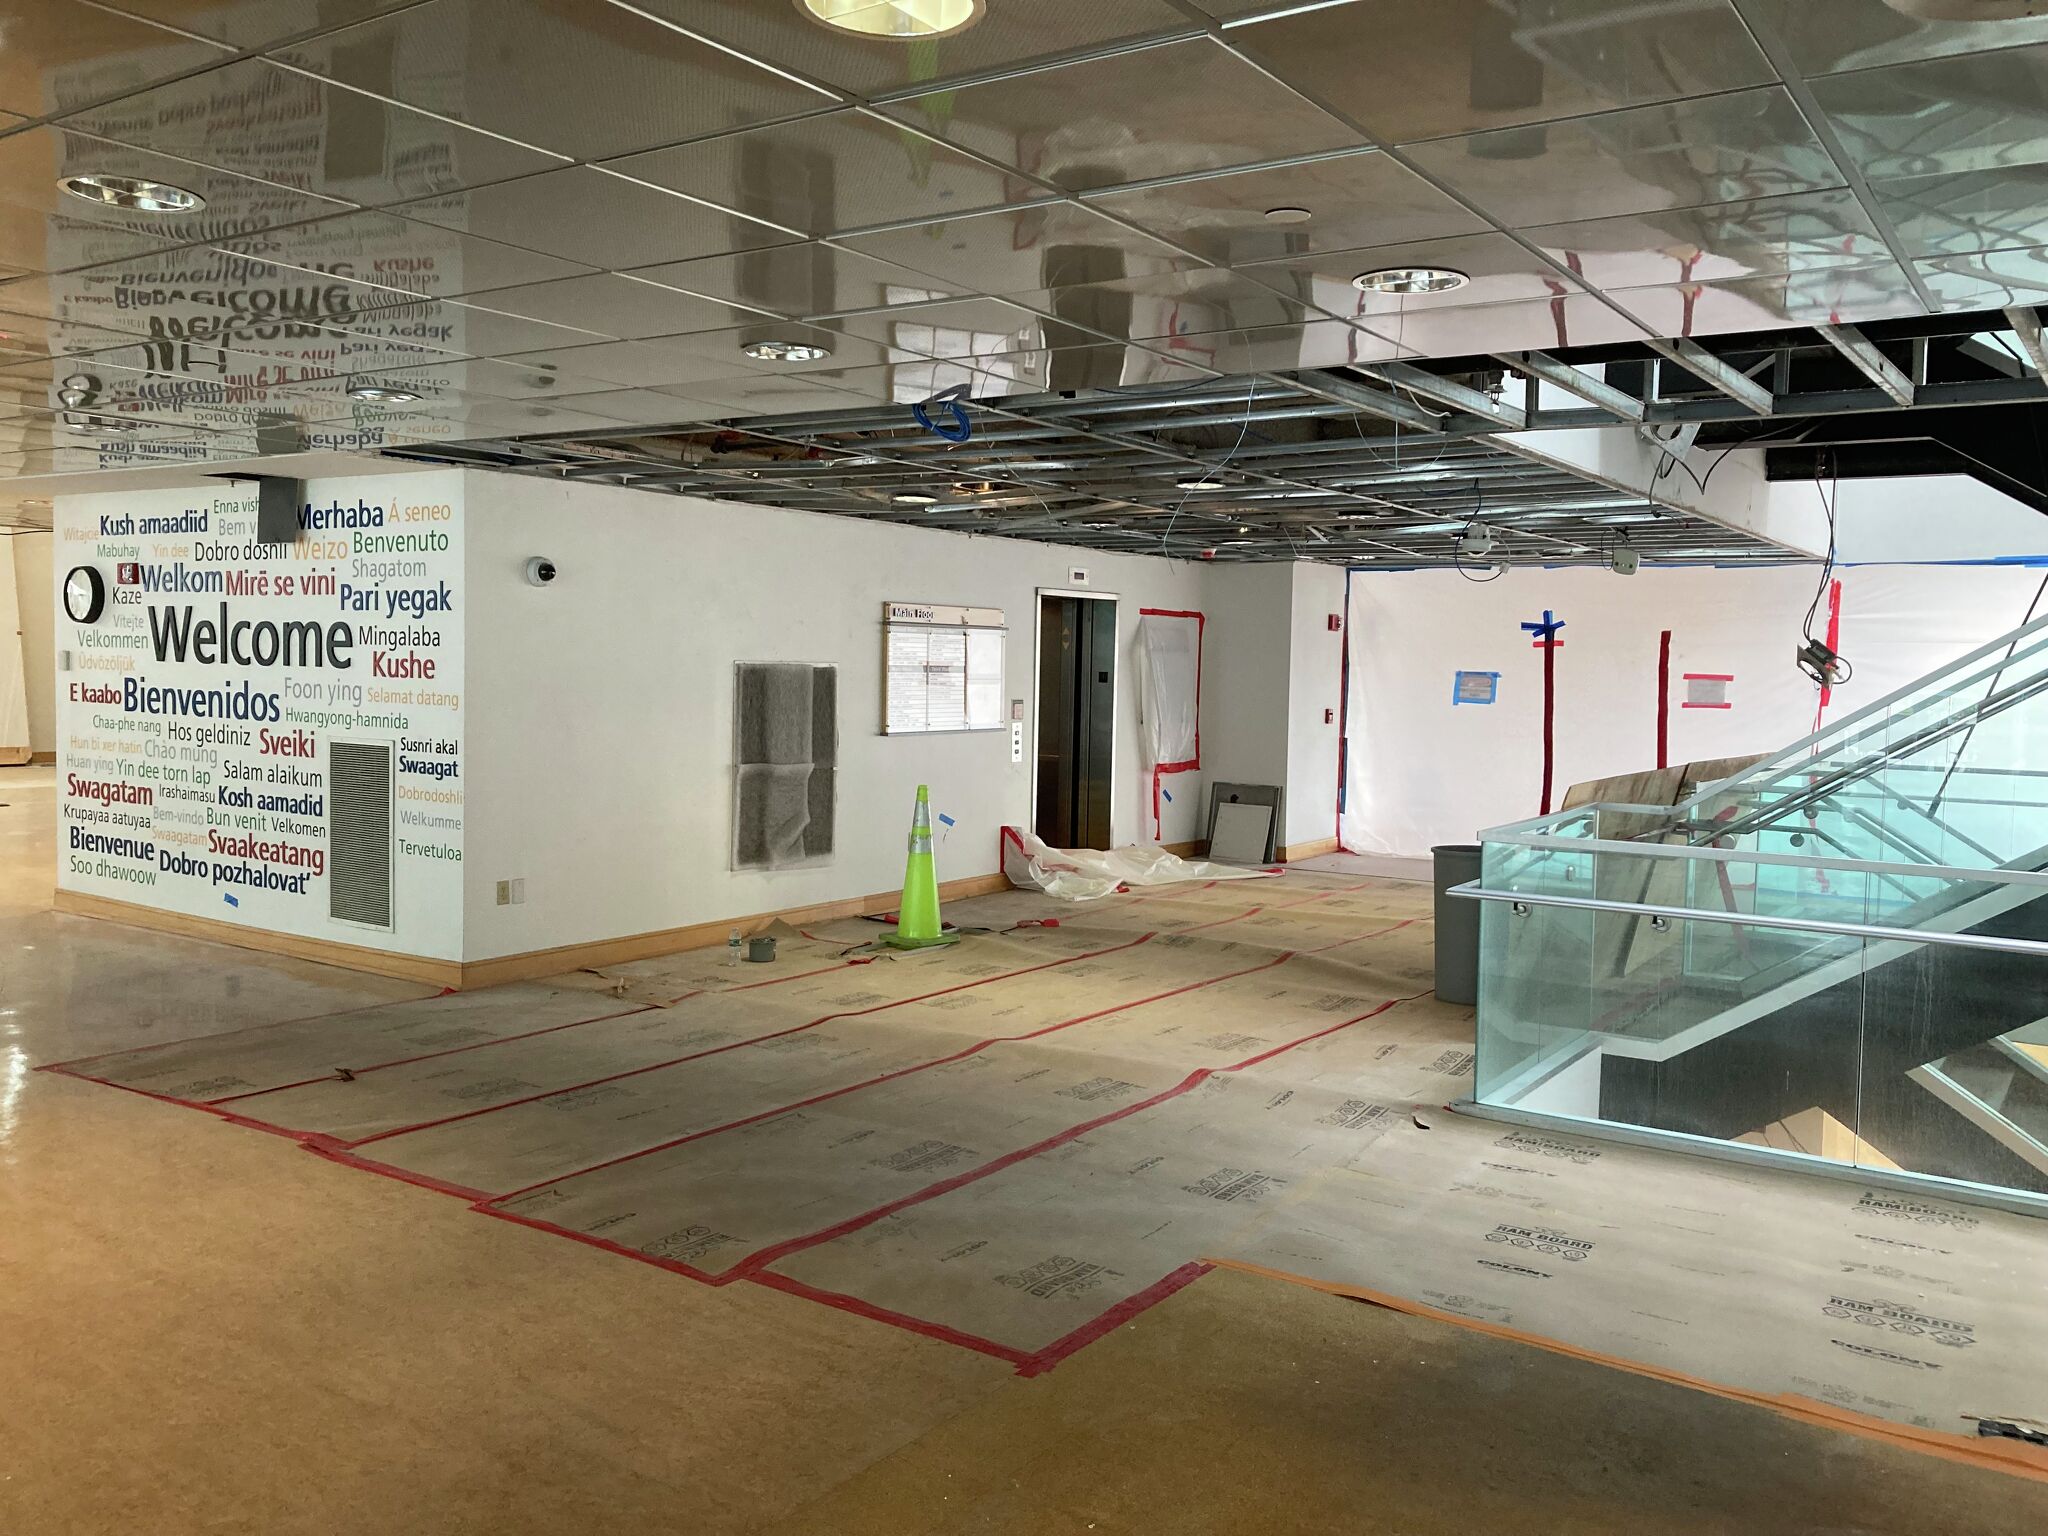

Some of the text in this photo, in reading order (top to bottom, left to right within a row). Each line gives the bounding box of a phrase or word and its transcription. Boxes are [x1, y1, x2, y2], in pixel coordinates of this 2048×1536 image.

[214, 499, 239, 514] Enna
[297, 498, 384, 530] Merhaba
[404, 503, 451, 522] seneo
[100, 508, 208, 536] Kush amaadiid
[218, 518, 246, 536] Bem
[97, 542, 140, 561] Mabuhay
[172, 544, 189, 558] dee
[195, 539, 239, 562] Dobro
[292, 534, 348, 561] Weizo
[353, 529, 449, 554] Benvenuto
[140, 562, 223, 593] Welkom
[274, 575, 294, 596] se
[299, 567, 336, 596] vini
[352, 558, 427, 584] Shagatom
[112, 586, 142, 605] Kaze
[340, 580, 452, 620] Pari yegak
[77, 628, 149, 649] Velkommen
[147, 601, 353, 669] Welcome
[359, 625, 441, 652] Mingalaba
[372, 650, 436, 680] Kushe
[70, 682, 122, 705] E kaabo
[124, 676, 280, 723] Bienvenidos
[284, 677, 363, 708] Foon ying
[367, 687, 459, 711] Selamat datang
[92, 714, 162, 737] Chaa-phe nang
[285, 707, 410, 730] Hwangyong-hamnida
[168, 721, 251, 748] Hos geldiniz
[259, 728, 315, 758] Sveiki
[400, 736, 458, 755] Susnri akal
[66, 752, 114, 775] Huan ying
[116, 757, 211, 789] Yin dee torn lap
[223, 760, 323, 788] Salam alaikum
[399, 755, 459, 781] Swaagat
[67, 772, 153, 807] Swagatam
[159, 783, 215, 804] Irashaimasu
[218, 785, 323, 817] Kosh aamadid
[398, 785, 463, 805] Dobrodoshli
[64, 803, 151, 831] Krupayaa aatuyaa
[152, 805, 204, 826] Bem-vindo
[206, 807, 267, 832] Bun venit
[271, 816, 326, 838] Velkomen
[400, 810, 462, 830] Welkumme
[70, 825, 154, 861] Bienvenue
[151, 825, 207, 847] Swaagatam
[208, 828, 324, 876] Svaakeatang
[399, 838, 462, 861] Tervetuloa
[70, 855, 157, 886] Soo dhawoow
[159, 850, 208, 878] Dobro
